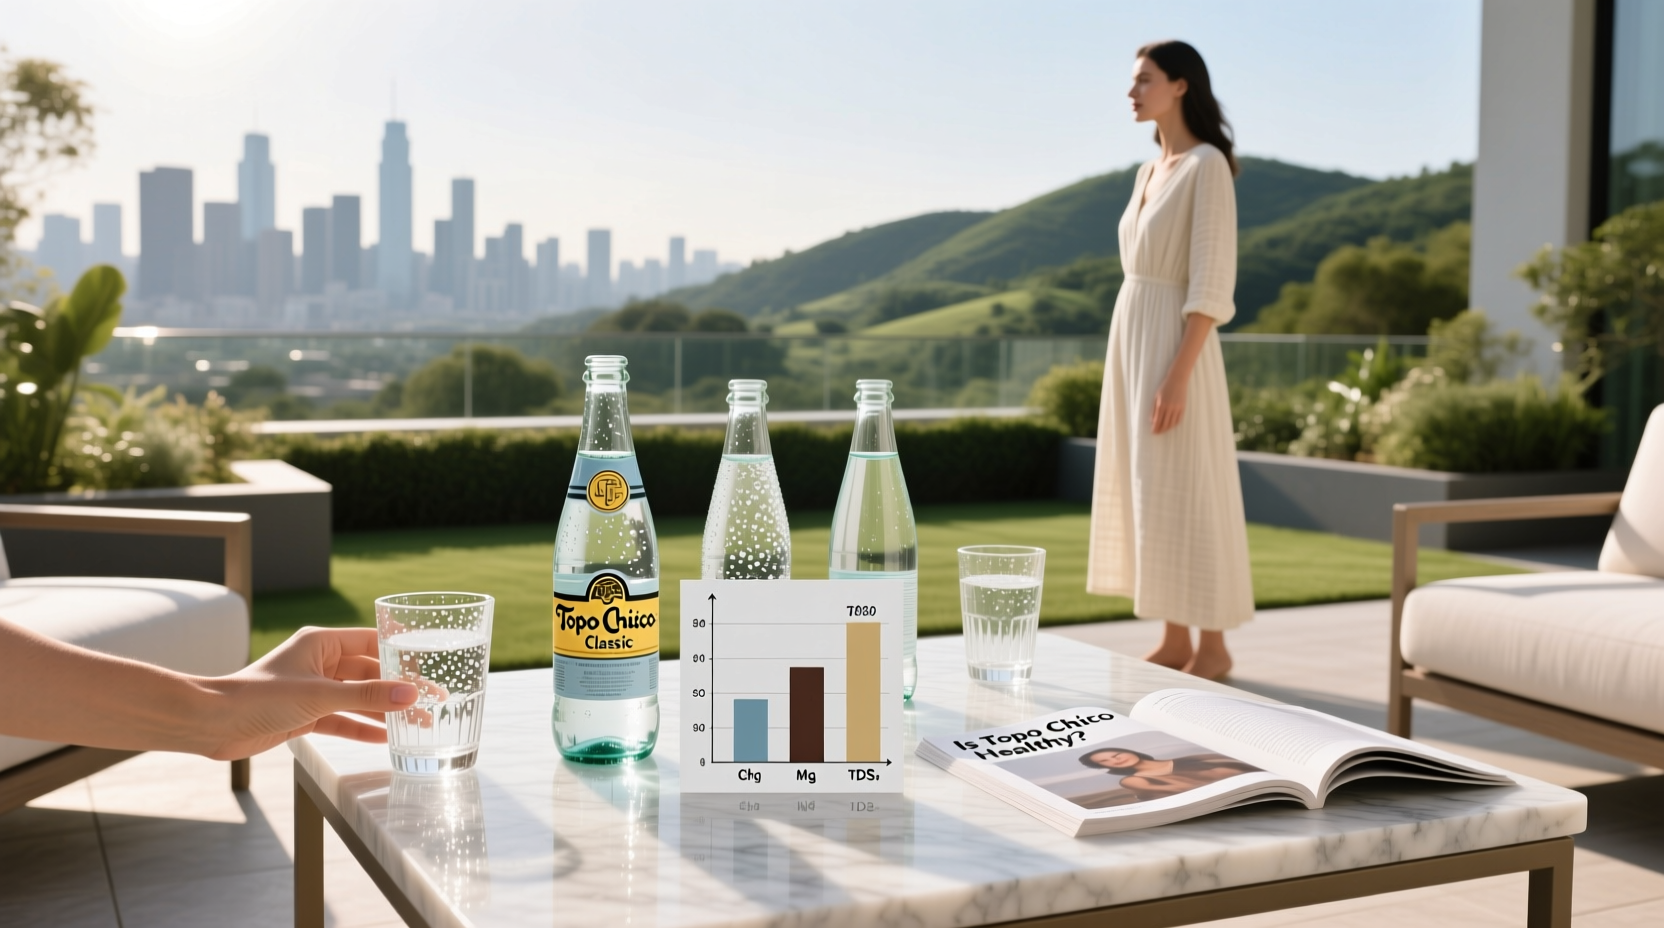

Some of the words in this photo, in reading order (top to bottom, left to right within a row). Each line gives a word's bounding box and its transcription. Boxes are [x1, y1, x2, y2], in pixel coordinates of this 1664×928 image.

[555, 603, 600, 636] Topo
[585, 634, 634, 650] Classic
[953, 740, 979, 751] Is
[979, 729, 1043, 746] Topo
[1046, 713, 1115, 732] Chico
[973, 730, 1087, 760] Healthy?
[737, 768, 762, 784] Chg
[796, 768, 817, 785] Mg
